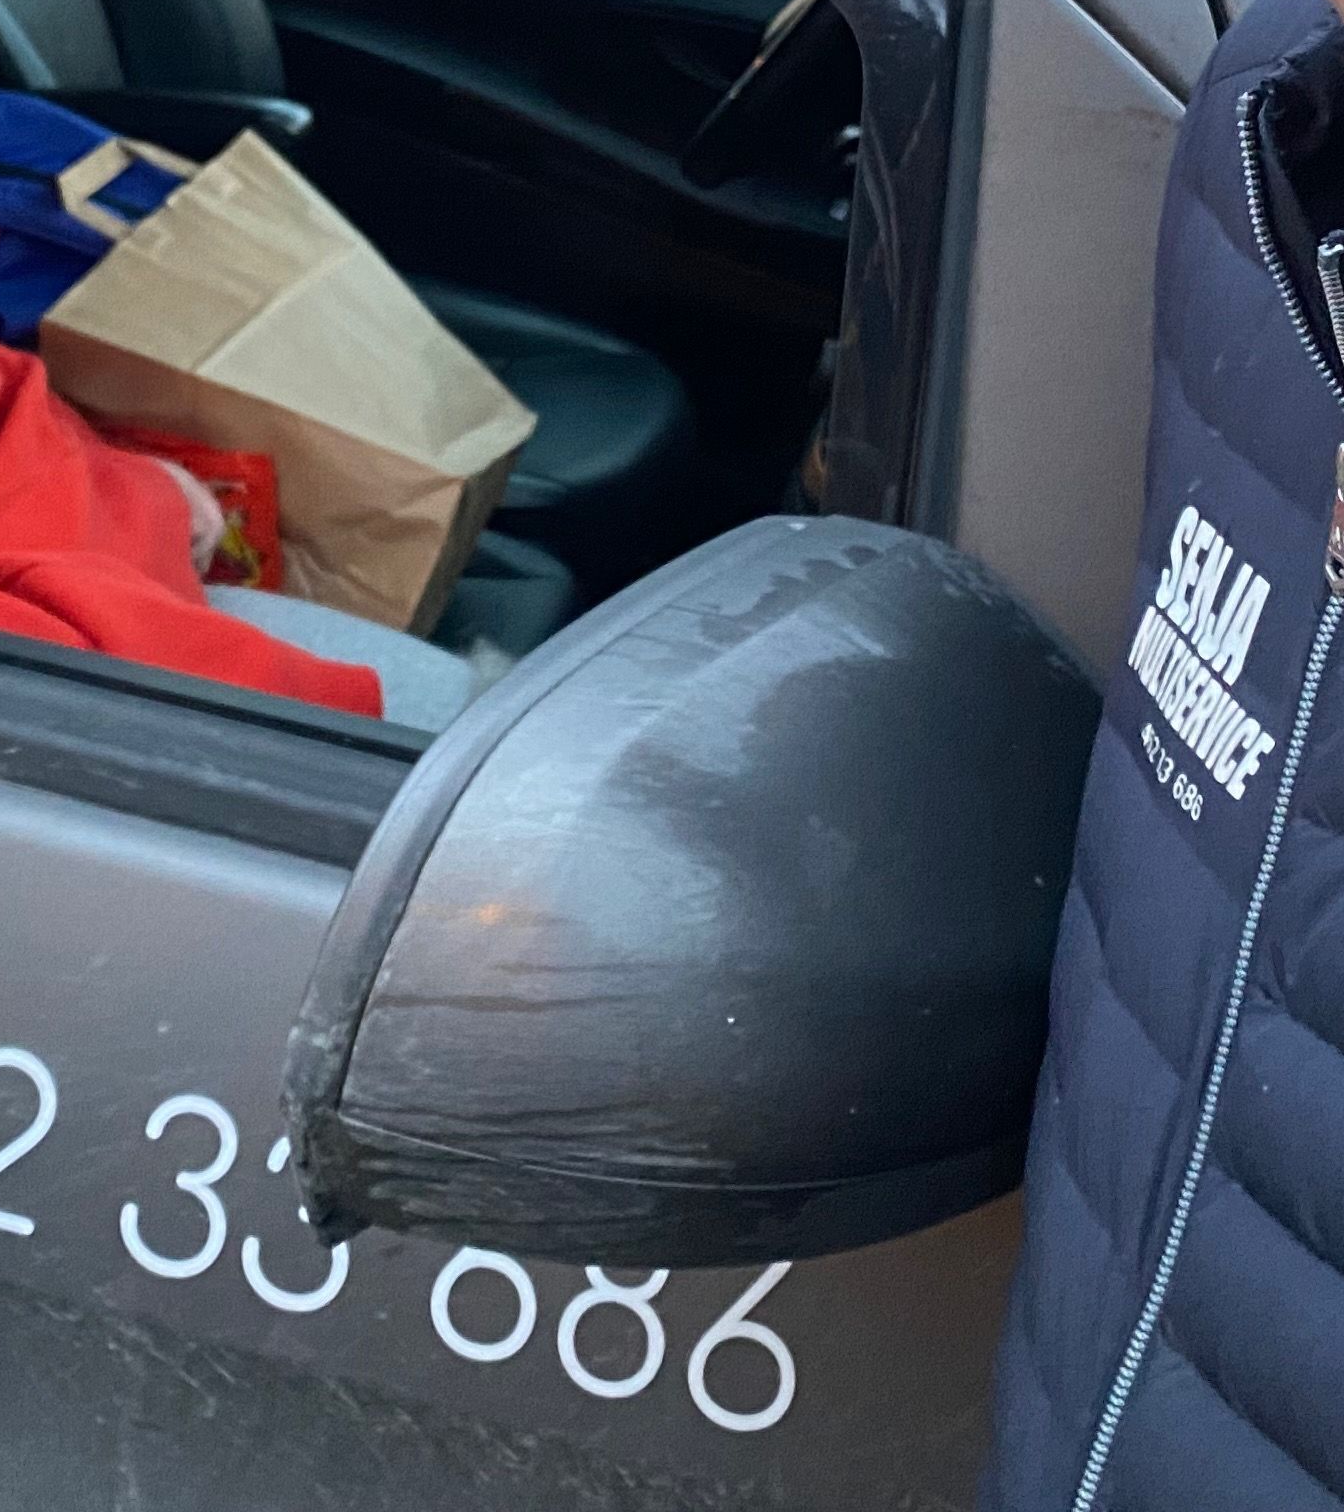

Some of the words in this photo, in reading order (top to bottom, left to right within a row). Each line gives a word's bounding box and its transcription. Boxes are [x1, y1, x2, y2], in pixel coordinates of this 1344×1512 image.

[1155, 505, 1271, 687] SENJA
[1127, 605, 1276, 801] MULTISERVICE
[1172, 773, 1204, 821] 686
